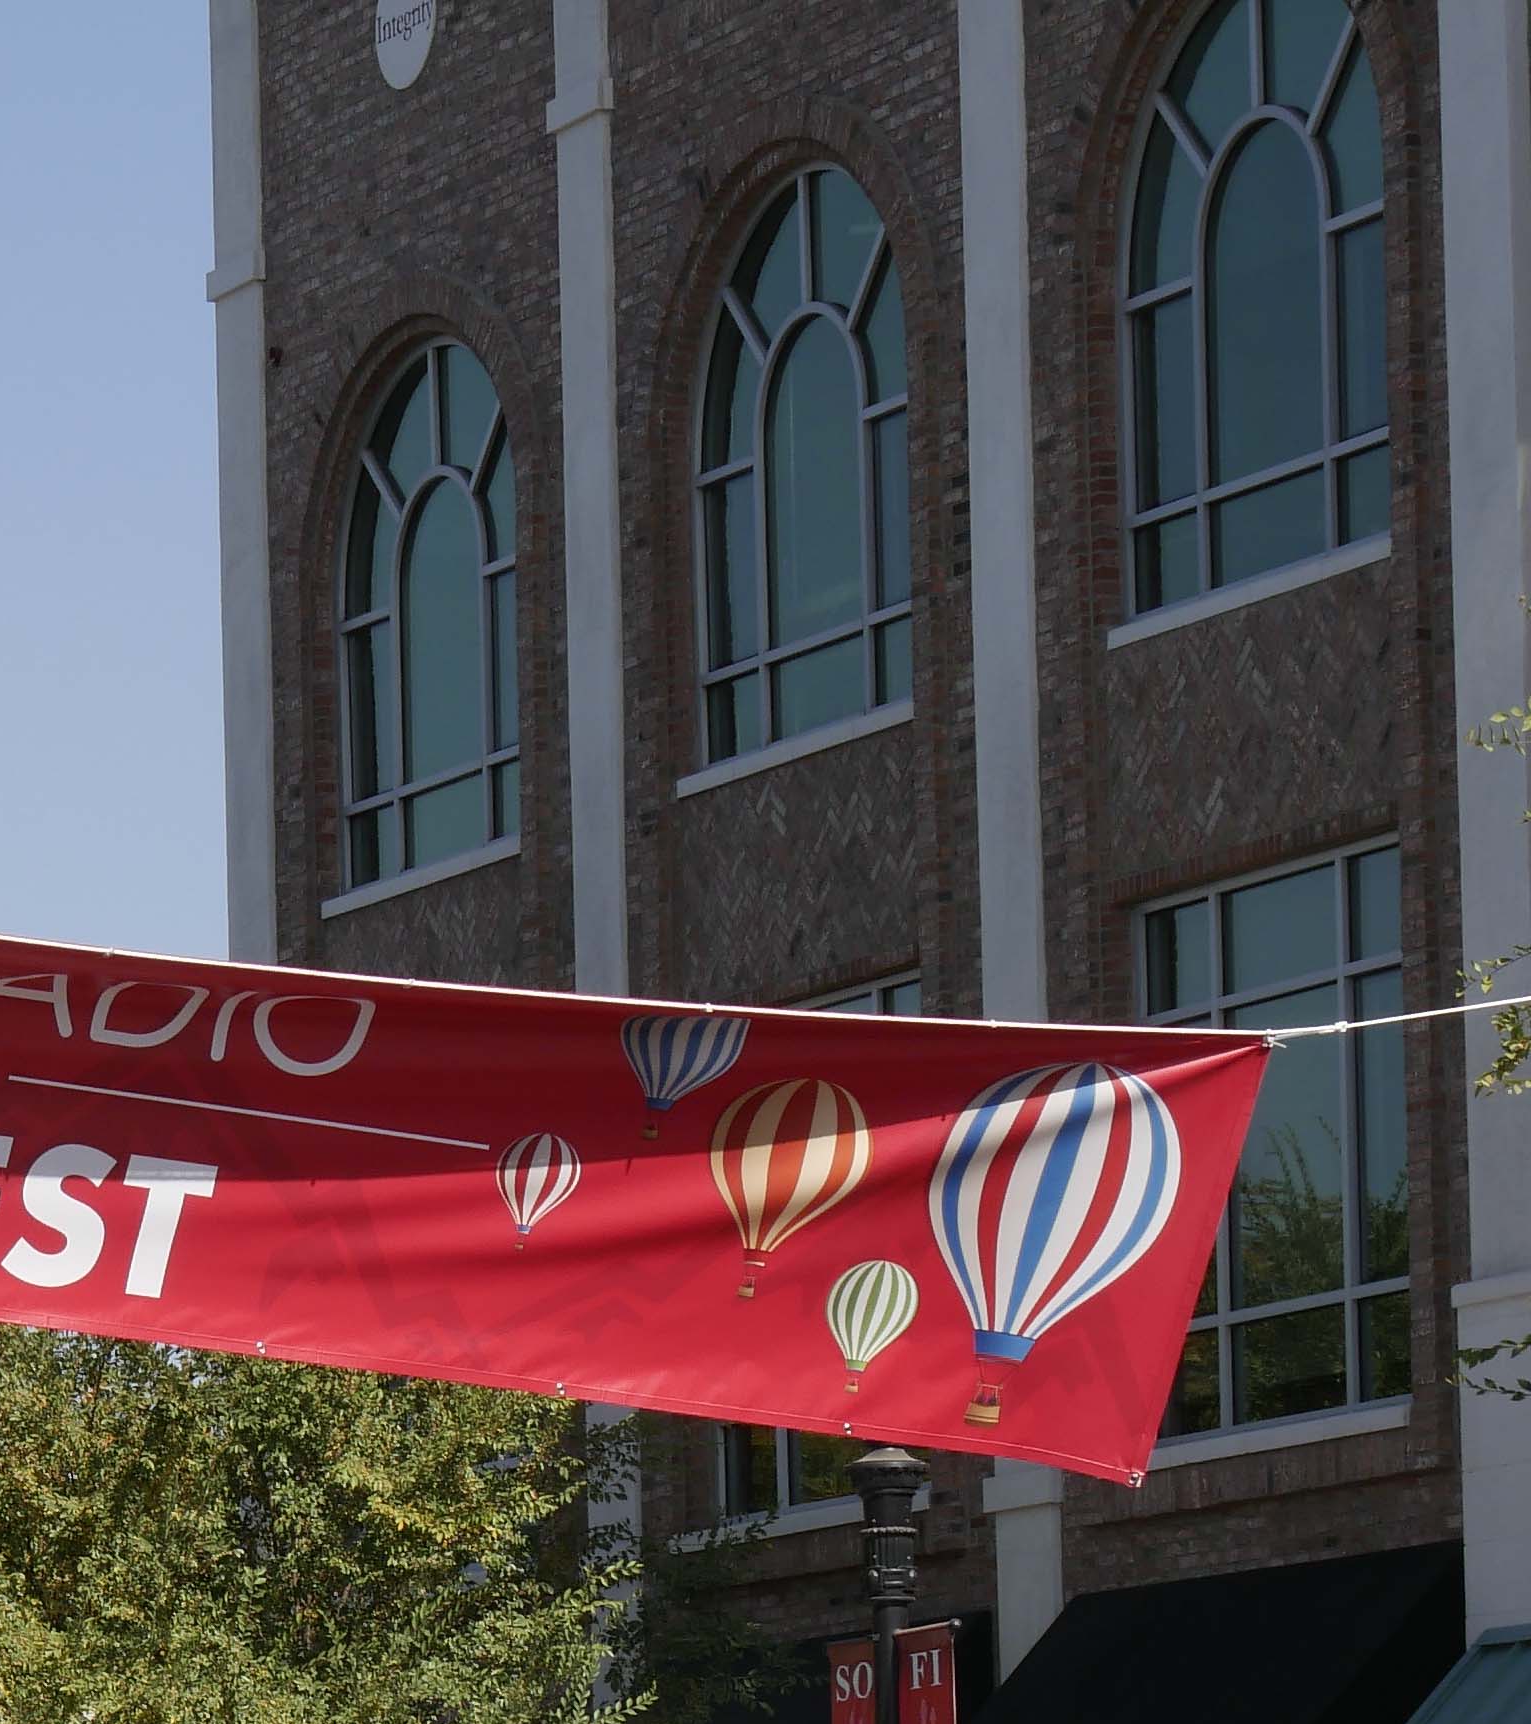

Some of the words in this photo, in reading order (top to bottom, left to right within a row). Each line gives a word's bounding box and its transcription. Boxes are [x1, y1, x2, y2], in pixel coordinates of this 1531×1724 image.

[377, 0, 433, 45] Integrity
[835, 1661, 874, 1702] SO
[909, 1649, 943, 1690] FI
